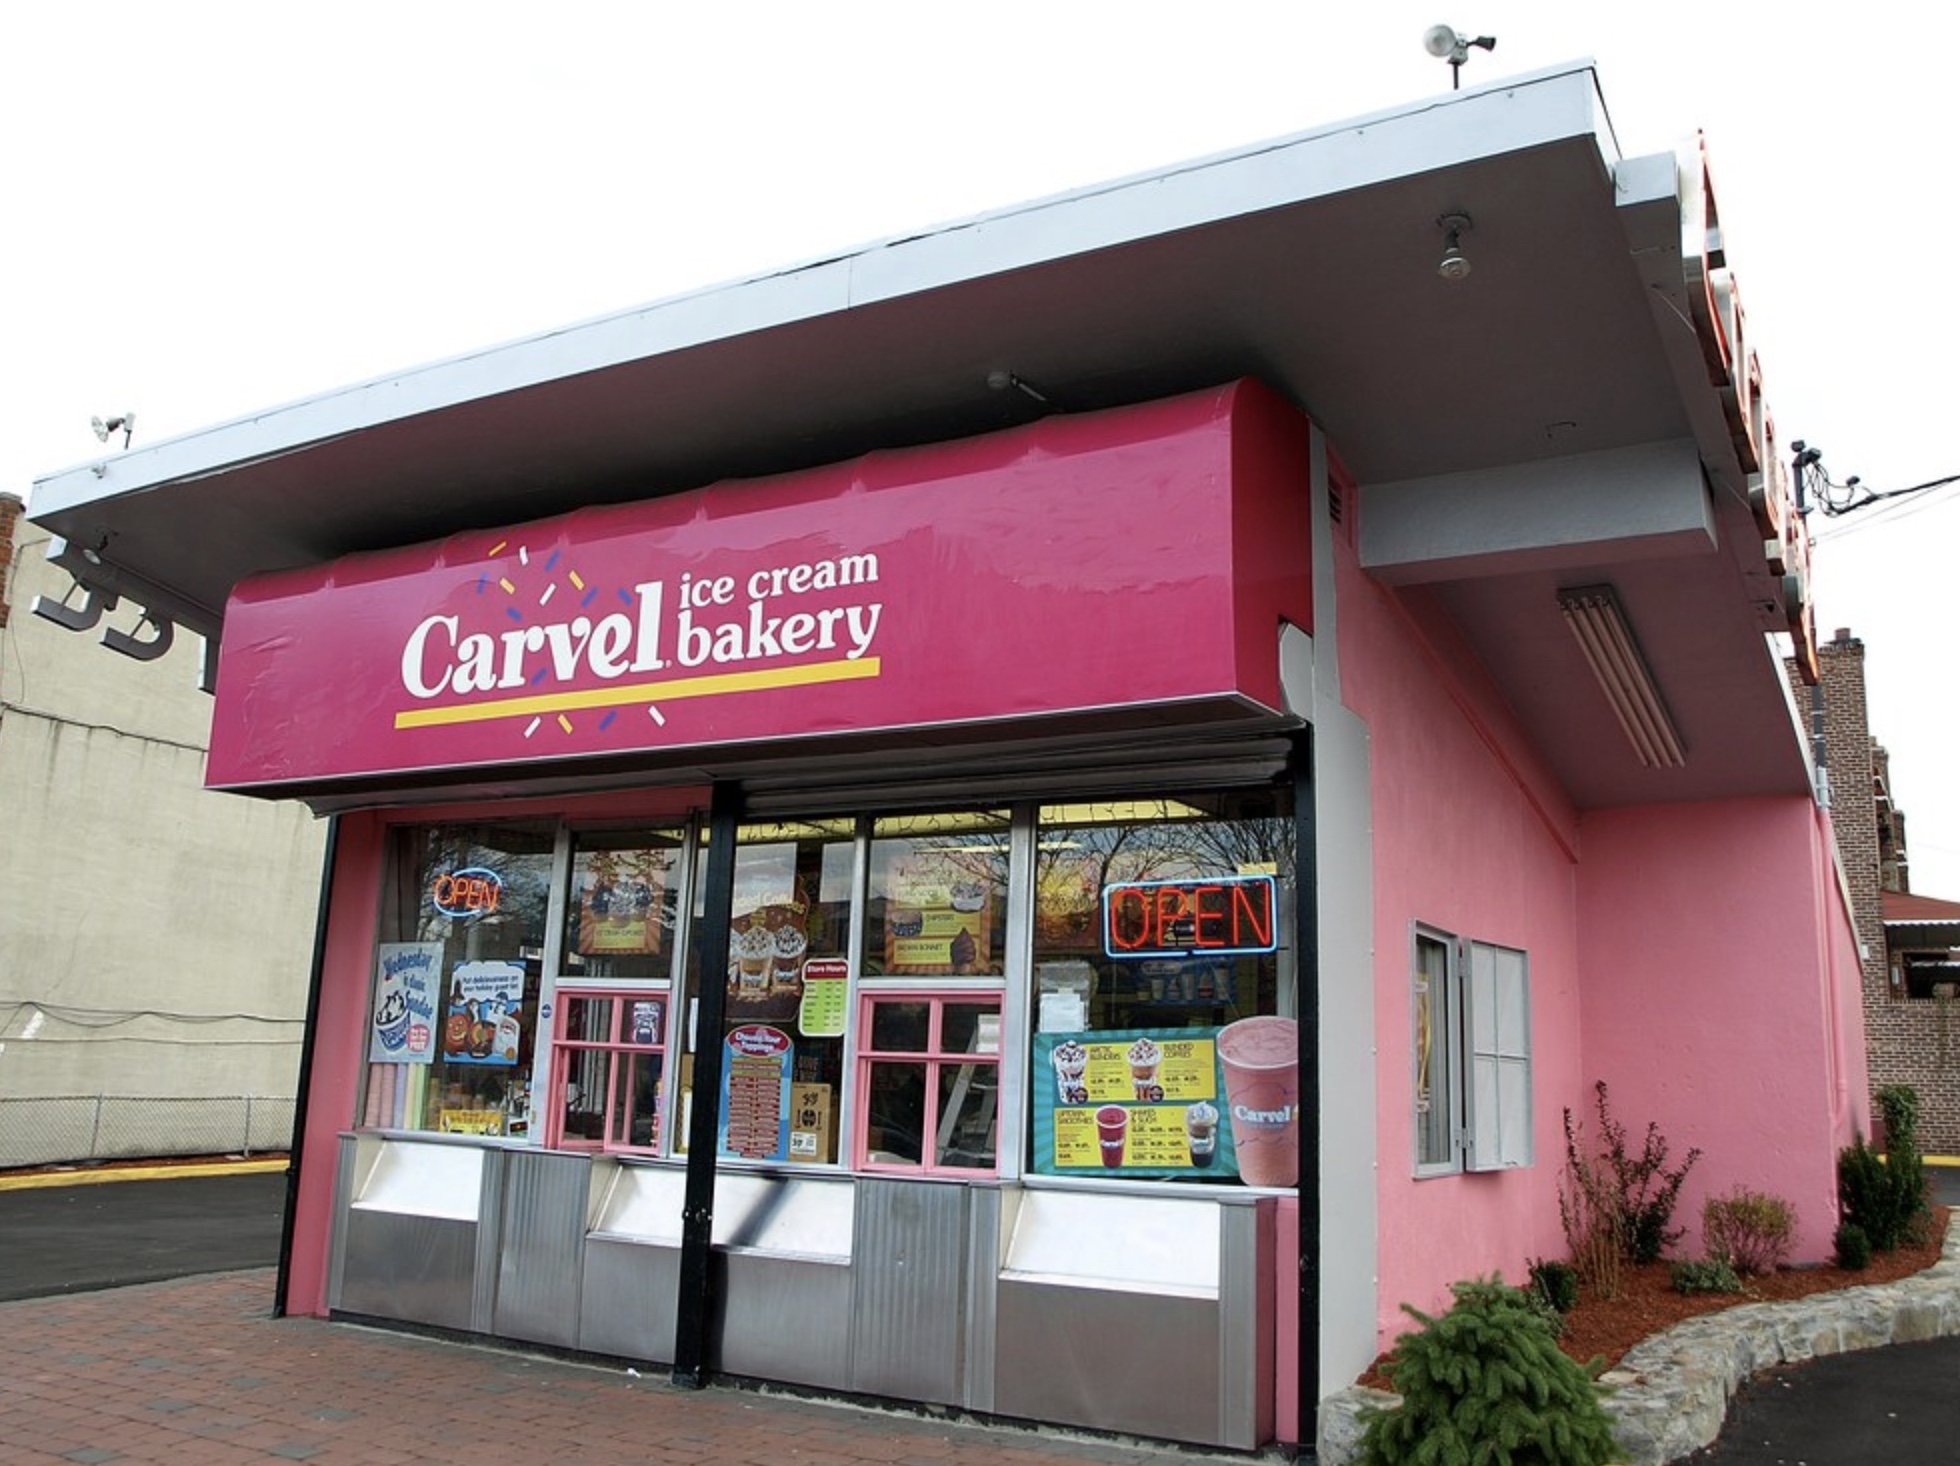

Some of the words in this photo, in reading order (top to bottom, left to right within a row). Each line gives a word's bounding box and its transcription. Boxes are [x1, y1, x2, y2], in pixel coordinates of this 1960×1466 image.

[679, 572, 735, 609] ice
[747, 553, 879, 599] cream
[401, 581, 664, 698] Carvel
[676, 600, 882, 668] bakery
[434, 874, 499, 911] OPEN
[1110, 882, 1271, 949] OPEN
[1234, 1105, 1291, 1122] Carvel
